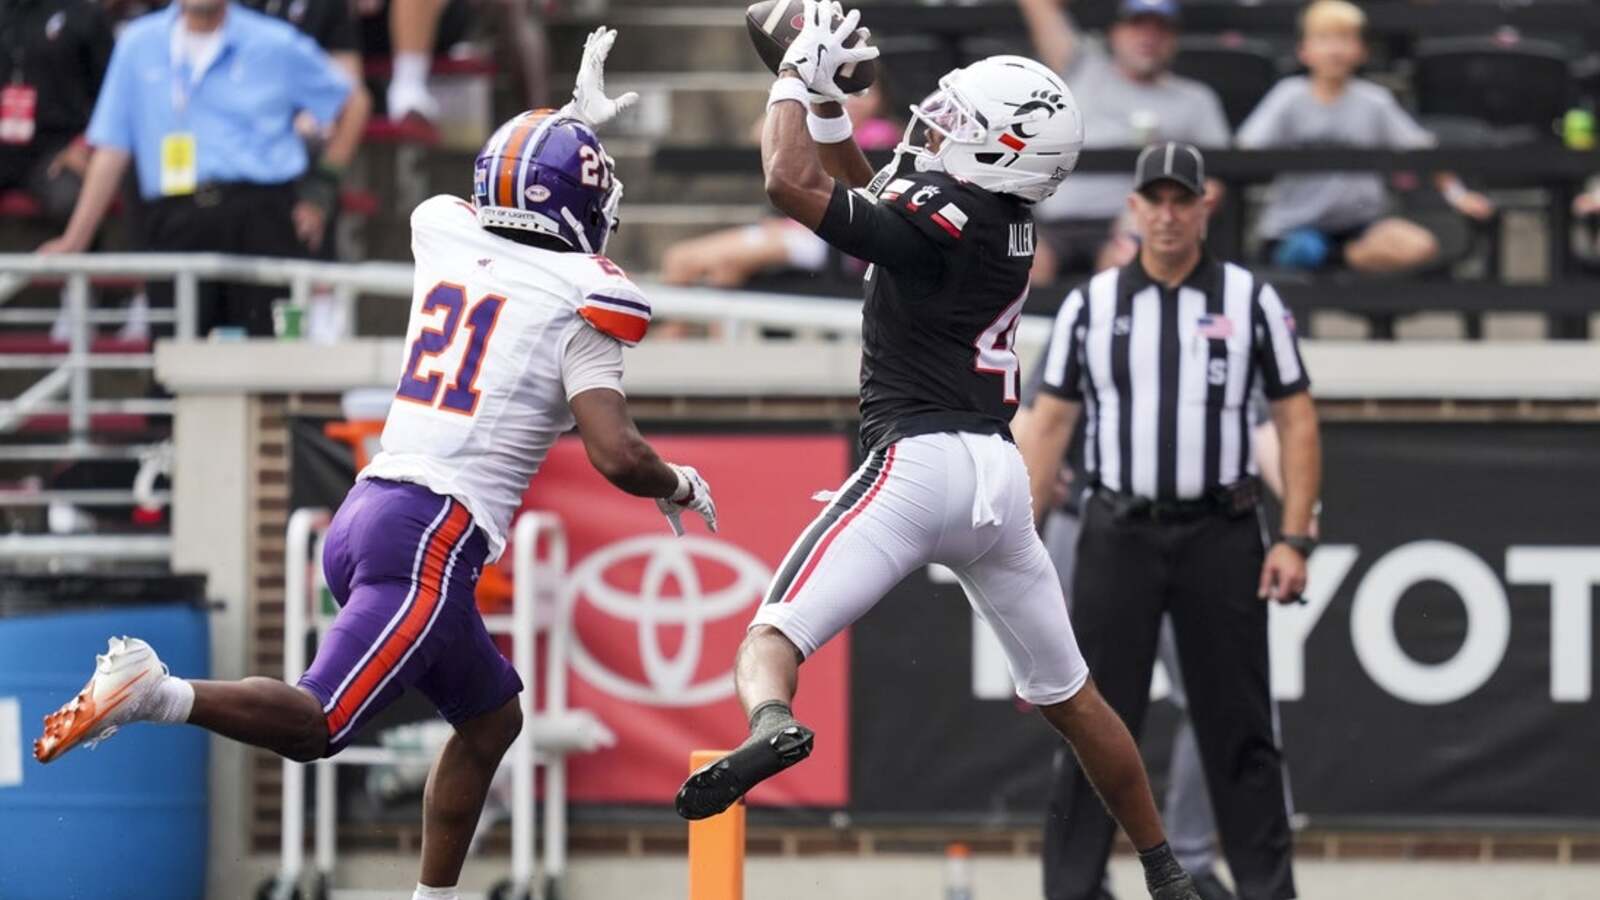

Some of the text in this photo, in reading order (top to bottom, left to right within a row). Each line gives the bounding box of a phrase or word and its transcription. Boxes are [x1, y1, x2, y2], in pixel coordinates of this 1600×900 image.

[1007, 222, 1035, 257] ALLEN
[395, 280, 508, 417] 21
[974, 270, 1031, 405] 4
[1208, 358, 1227, 386] S
